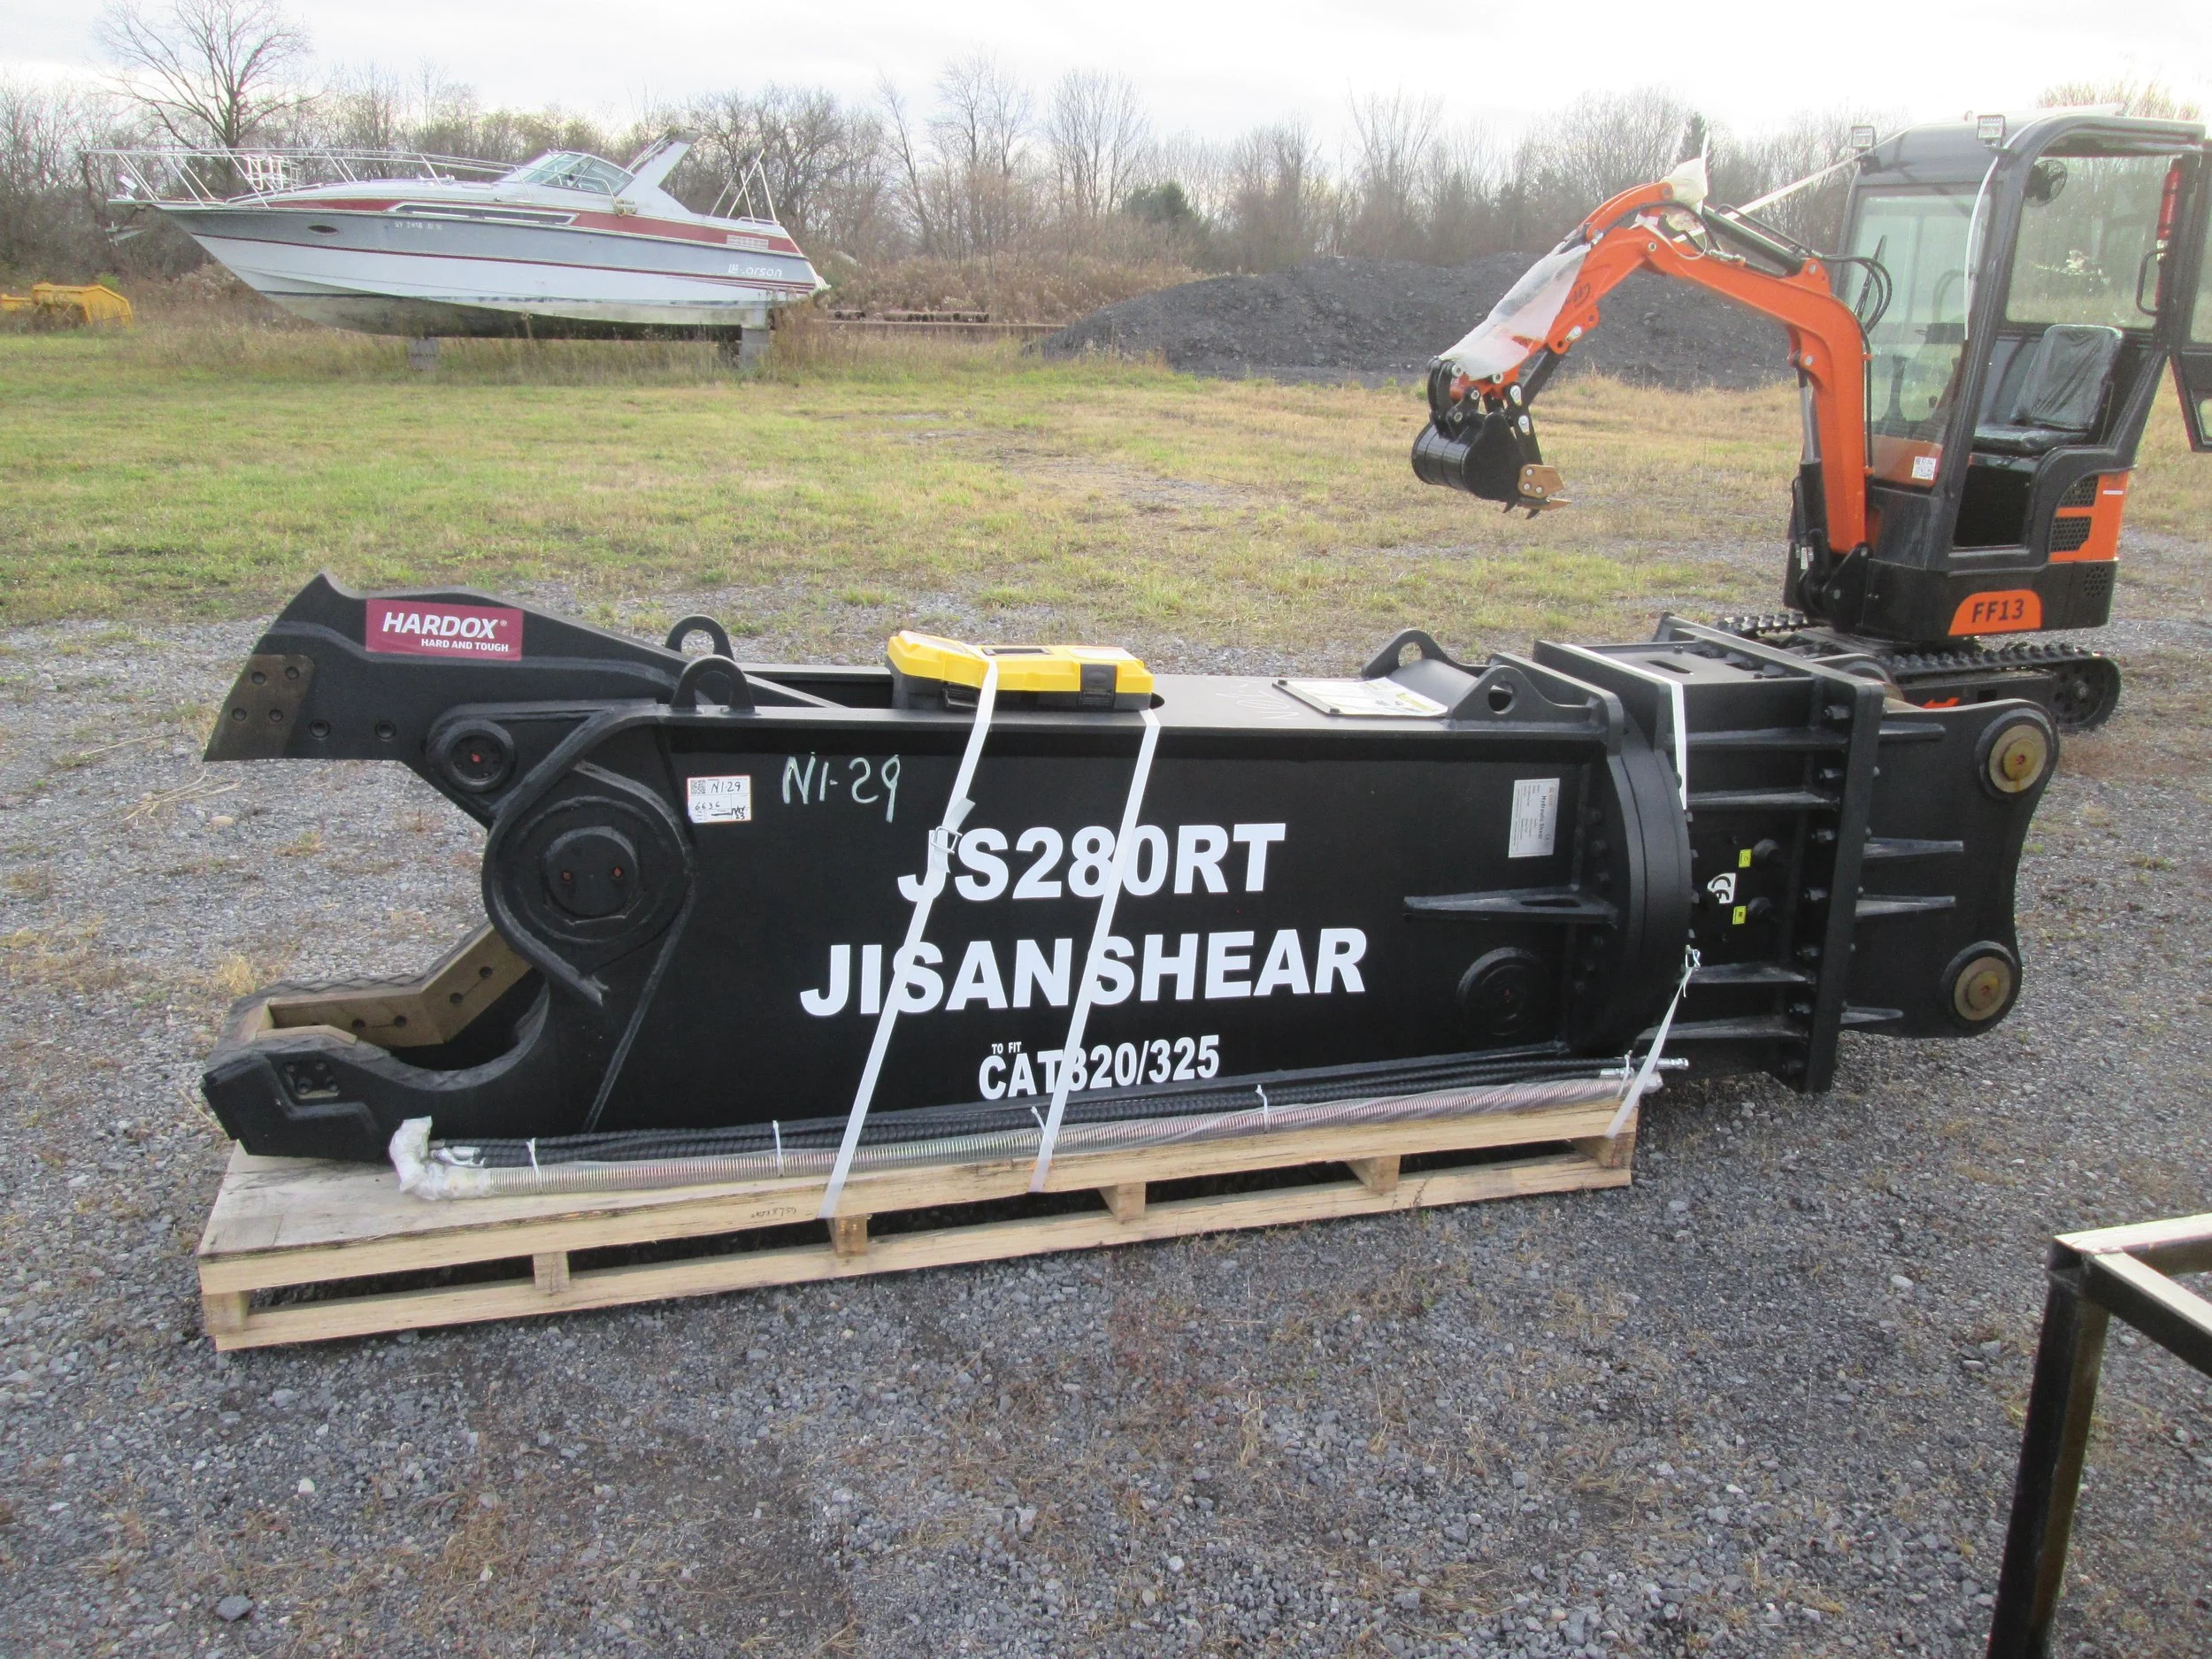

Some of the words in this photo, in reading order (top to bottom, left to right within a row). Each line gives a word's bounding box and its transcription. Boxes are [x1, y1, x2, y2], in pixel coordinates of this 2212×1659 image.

[1971, 598, 2024, 623] FF13
[382, 611, 498, 639] HARDOX
[421, 639, 449, 649] HARD
[451, 641, 472, 649] AND
[475, 641, 509, 652] TOUGH
[897, 823, 1286, 902] JS280RT
[800, 928, 1367, 1017] JISANSHEAR
[991, 1043, 1003, 1055] TO
[1009, 1041, 1022, 1053] FIT
